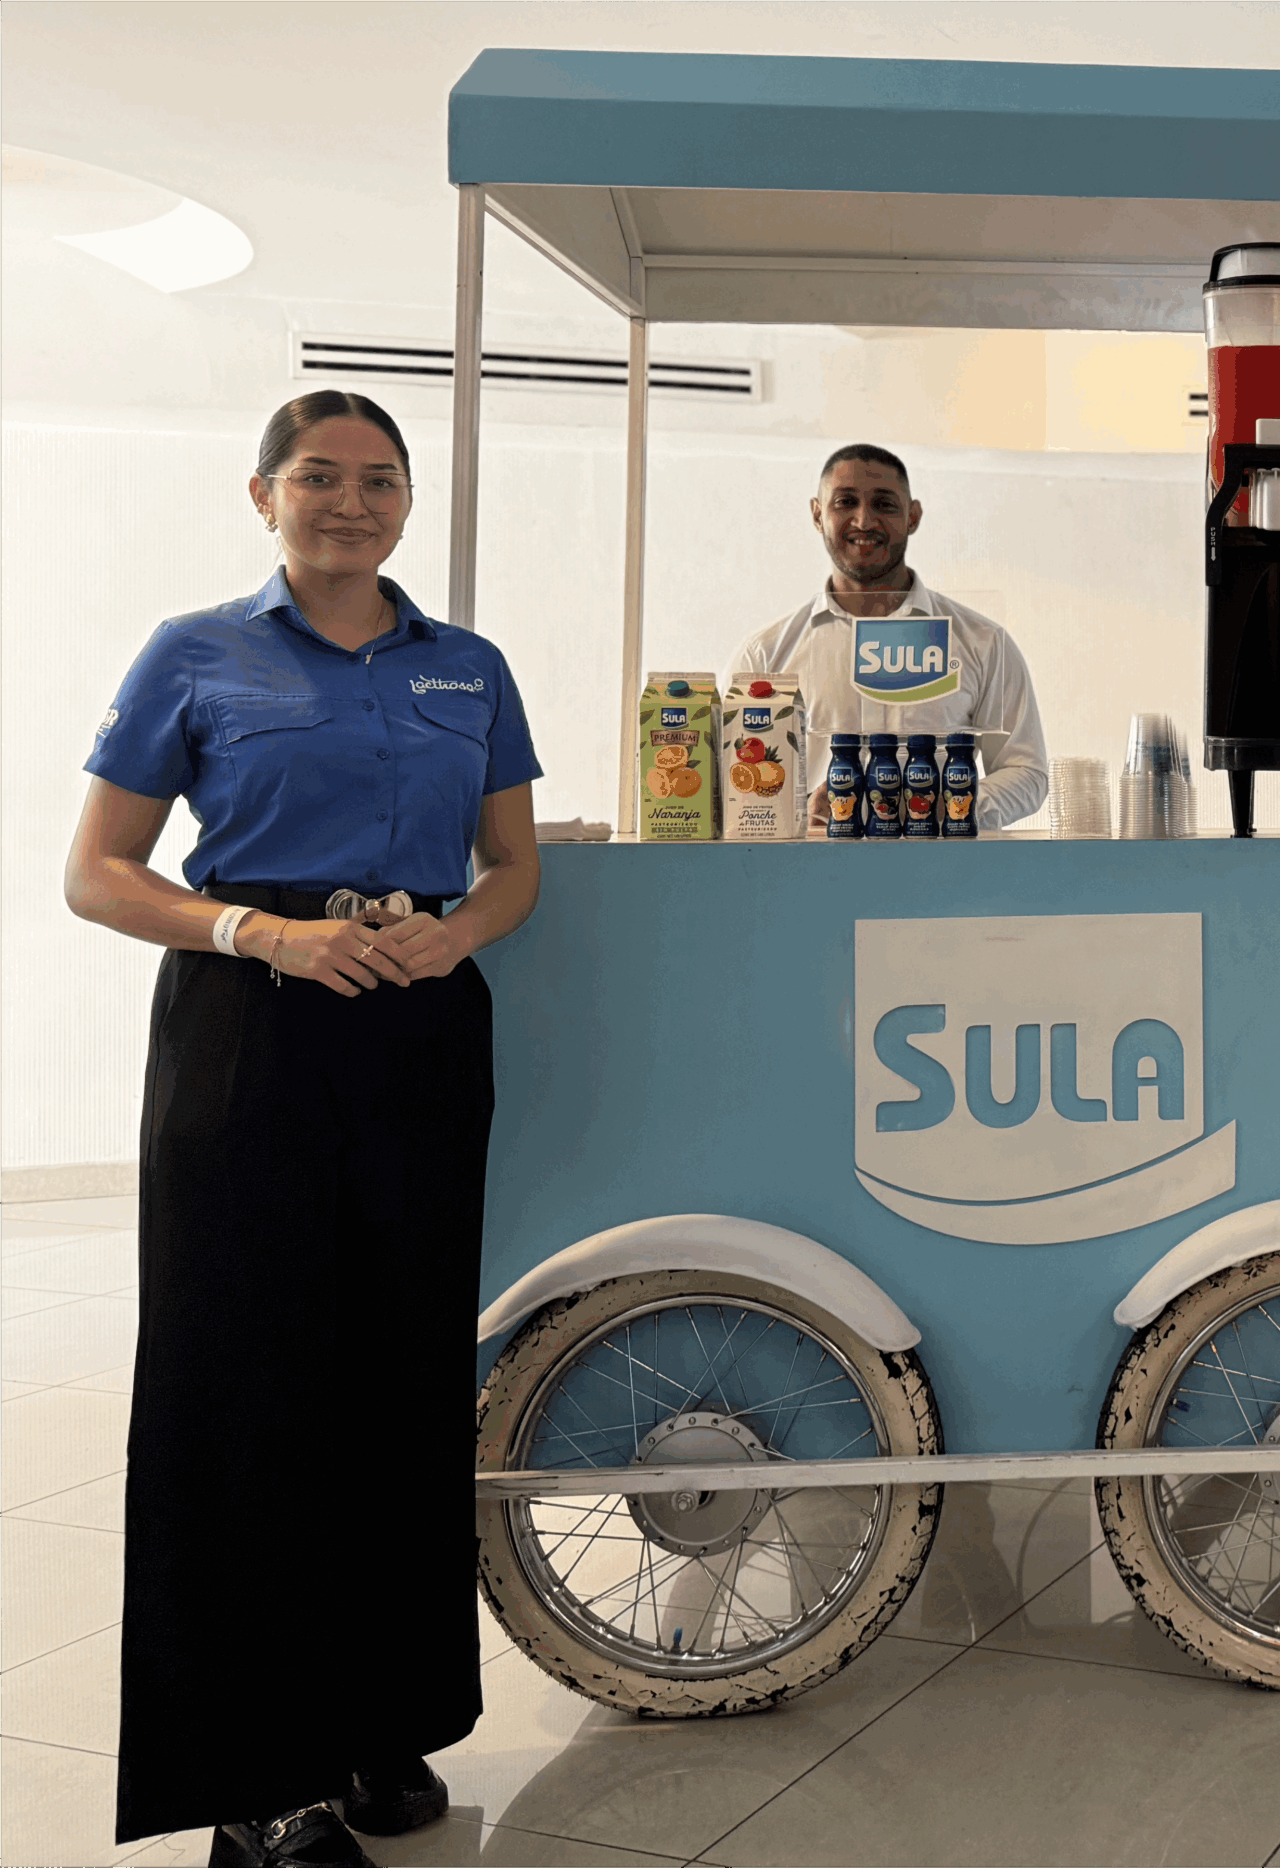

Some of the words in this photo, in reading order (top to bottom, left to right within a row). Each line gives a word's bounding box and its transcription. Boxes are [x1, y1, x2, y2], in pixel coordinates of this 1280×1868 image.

[859, 641, 944, 674] SULA
[662, 713, 686, 724] SULA
[744, 714, 770, 725] SULA
[654, 734, 696, 742] PREMIUM
[832, 773, 851, 781] SULA
[878, 773, 898, 781] SULA
[909, 771, 929, 780] SULA
[949, 773, 968, 781] SULA
[648, 808, 701, 821] Naranja
[738, 810, 777, 819] Ponche
[873, 1003, 1185, 1133] SULA
